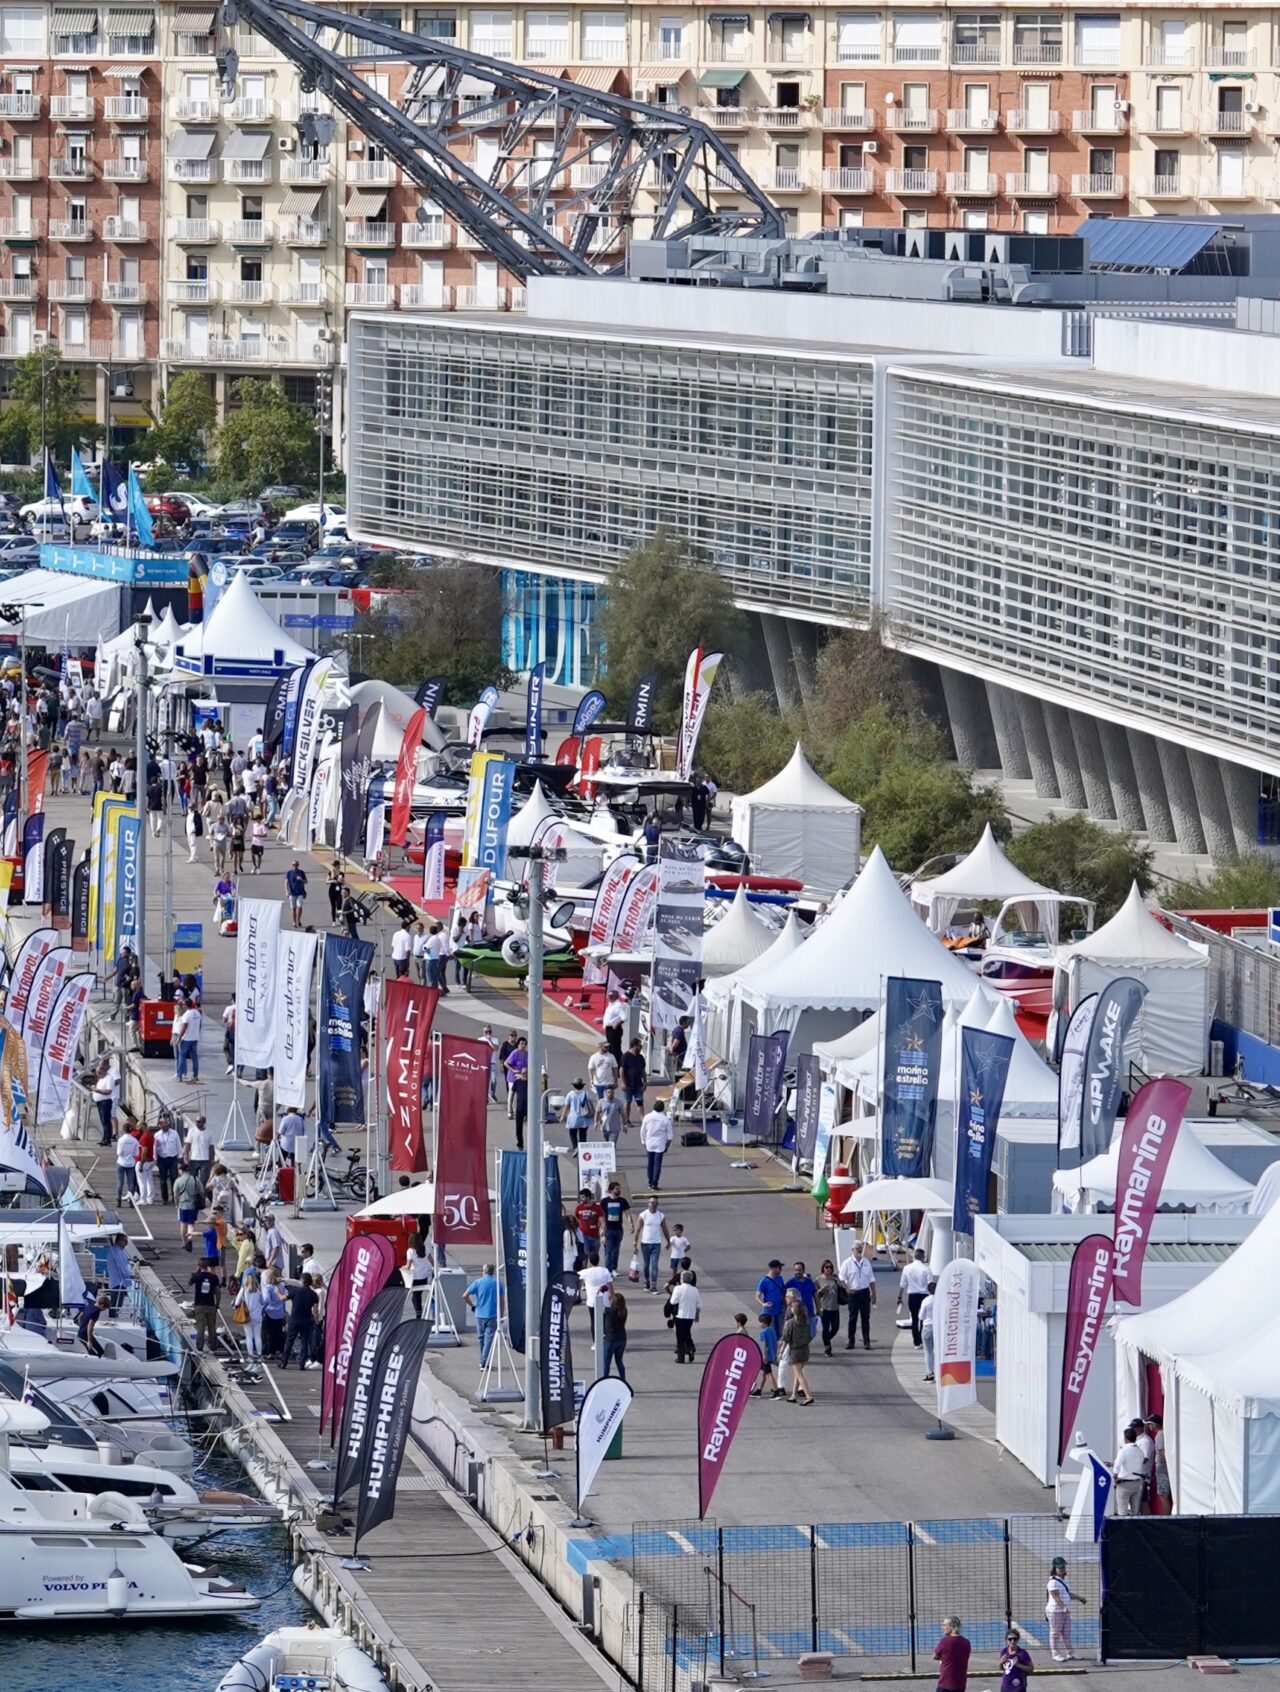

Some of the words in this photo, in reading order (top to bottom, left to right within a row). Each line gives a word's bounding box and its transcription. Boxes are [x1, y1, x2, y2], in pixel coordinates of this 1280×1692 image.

[484, 773, 506, 864] DUFOUR
[123, 829, 136, 927] DUFOUR
[434, 844, 443, 897] JEANNEAU
[591, 877, 620, 943] METROPOL
[616, 887, 648, 951] METROPOL
[10, 953, 39, 1012] METROPOL
[259, 941, 268, 999] YACHTS
[28, 973, 55, 1035] METROPOL
[48, 997, 77, 1062] METROPOL
[398, 999, 419, 1157] AZIMUT
[411, 1048, 421, 1112] YACHTS
[896, 1075, 929, 1086] estrella
[897, 1064, 929, 1076] marina
[442, 1194, 479, 1228] 50
[1113, 1113, 1167, 1278] Raymarine
[335, 1246, 370, 1387] Raymarine
[944, 1291, 961, 1357] Insteimed
[1067, 1247, 1110, 1395] Raymarine
[550, 1301, 562, 1401] HUMPHREE
[347, 1319, 383, 1460] HUMPHREE
[401, 1378, 411, 1407] Systems
[704, 1346, 748, 1463] Raymarine
[367, 1350, 404, 1500] HUMPHREE
[596, 1401, 621, 1443] HUMPHREE
[41, 1575, 70, 1583] Powered
[73, 1574, 86, 1585] by:
[43, 1583, 90, 1592] VOLVO
